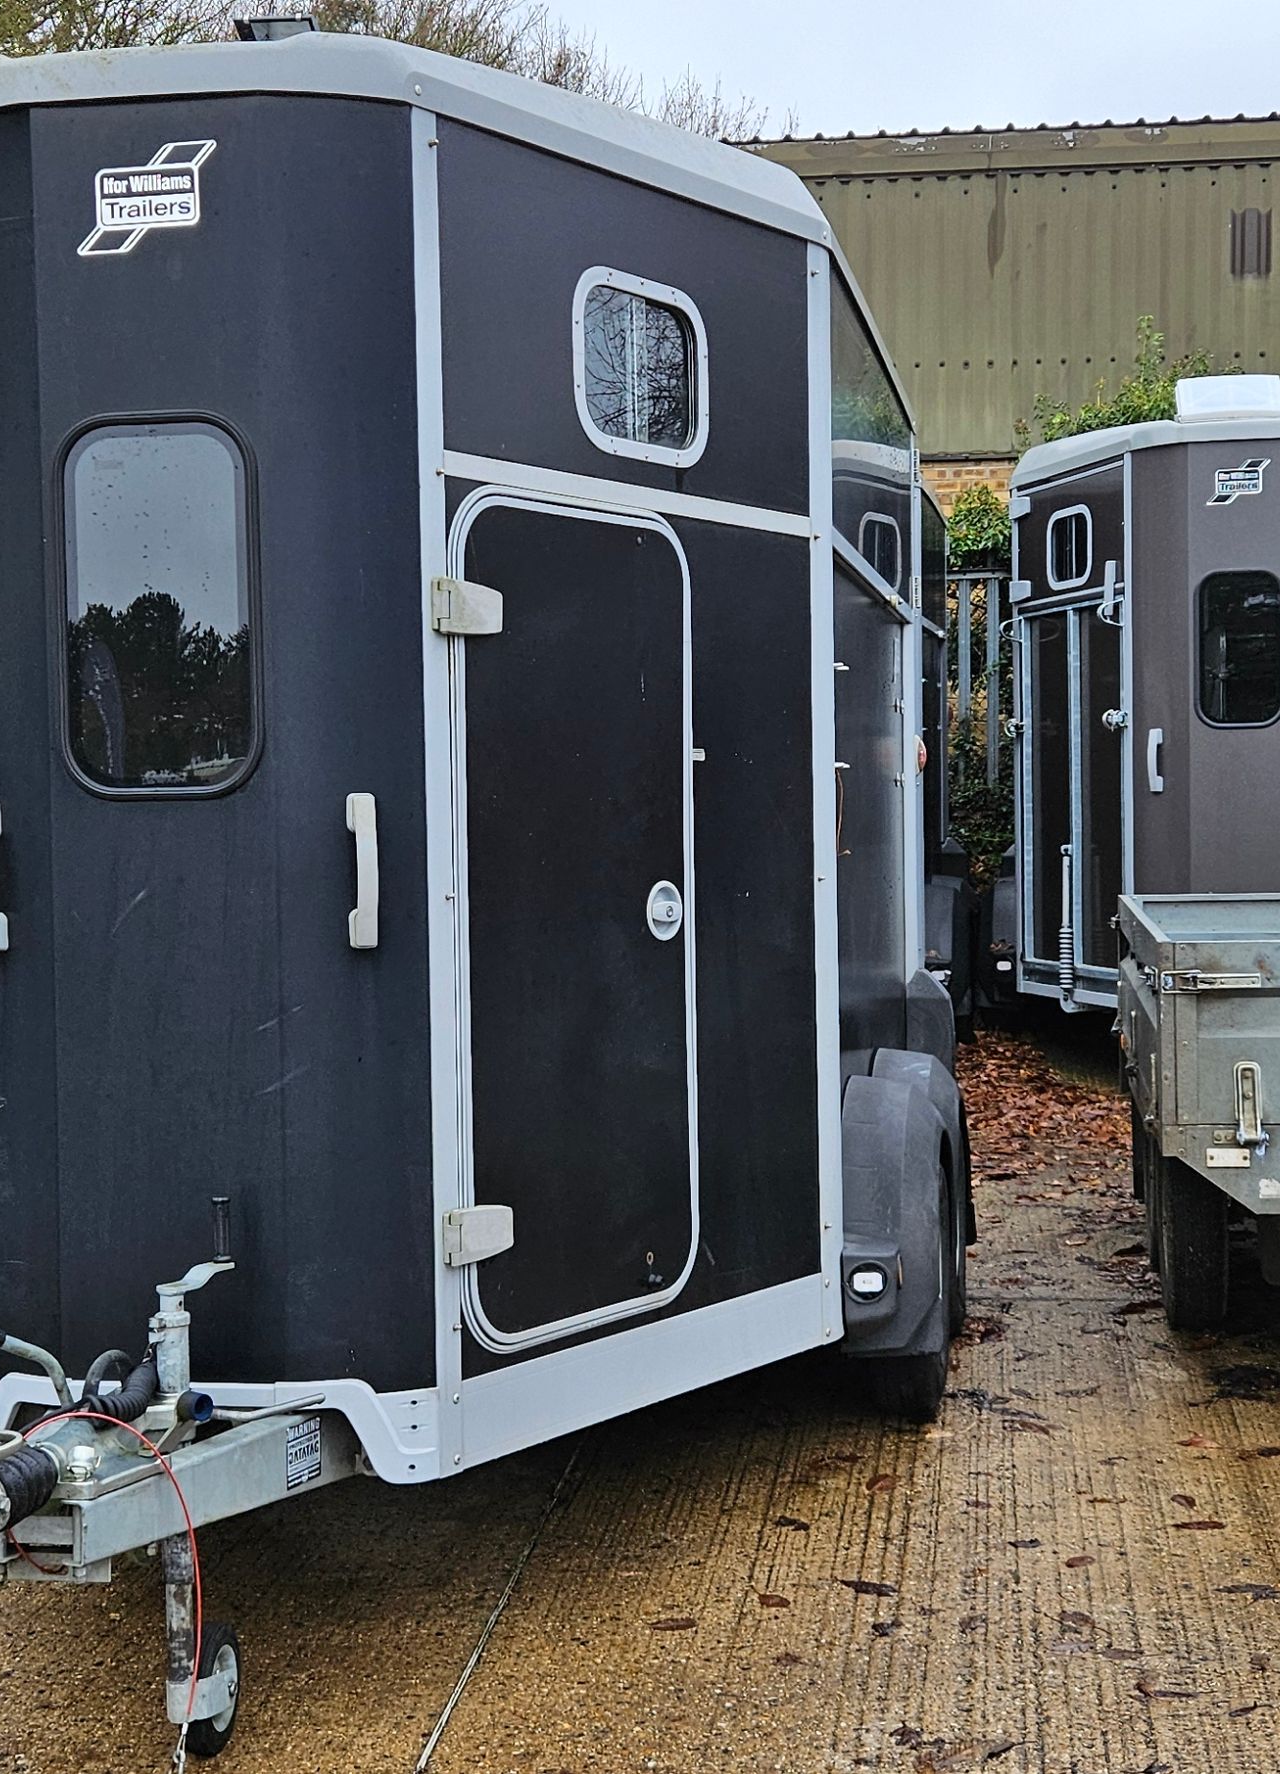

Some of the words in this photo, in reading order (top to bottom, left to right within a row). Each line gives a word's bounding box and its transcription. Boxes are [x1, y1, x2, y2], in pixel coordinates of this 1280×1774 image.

[103, 177, 128, 194] Ifor
[129, 174, 192, 192] Williams
[105, 200, 191, 218] Trailers
[287, 1417, 320, 1441] WARNING
